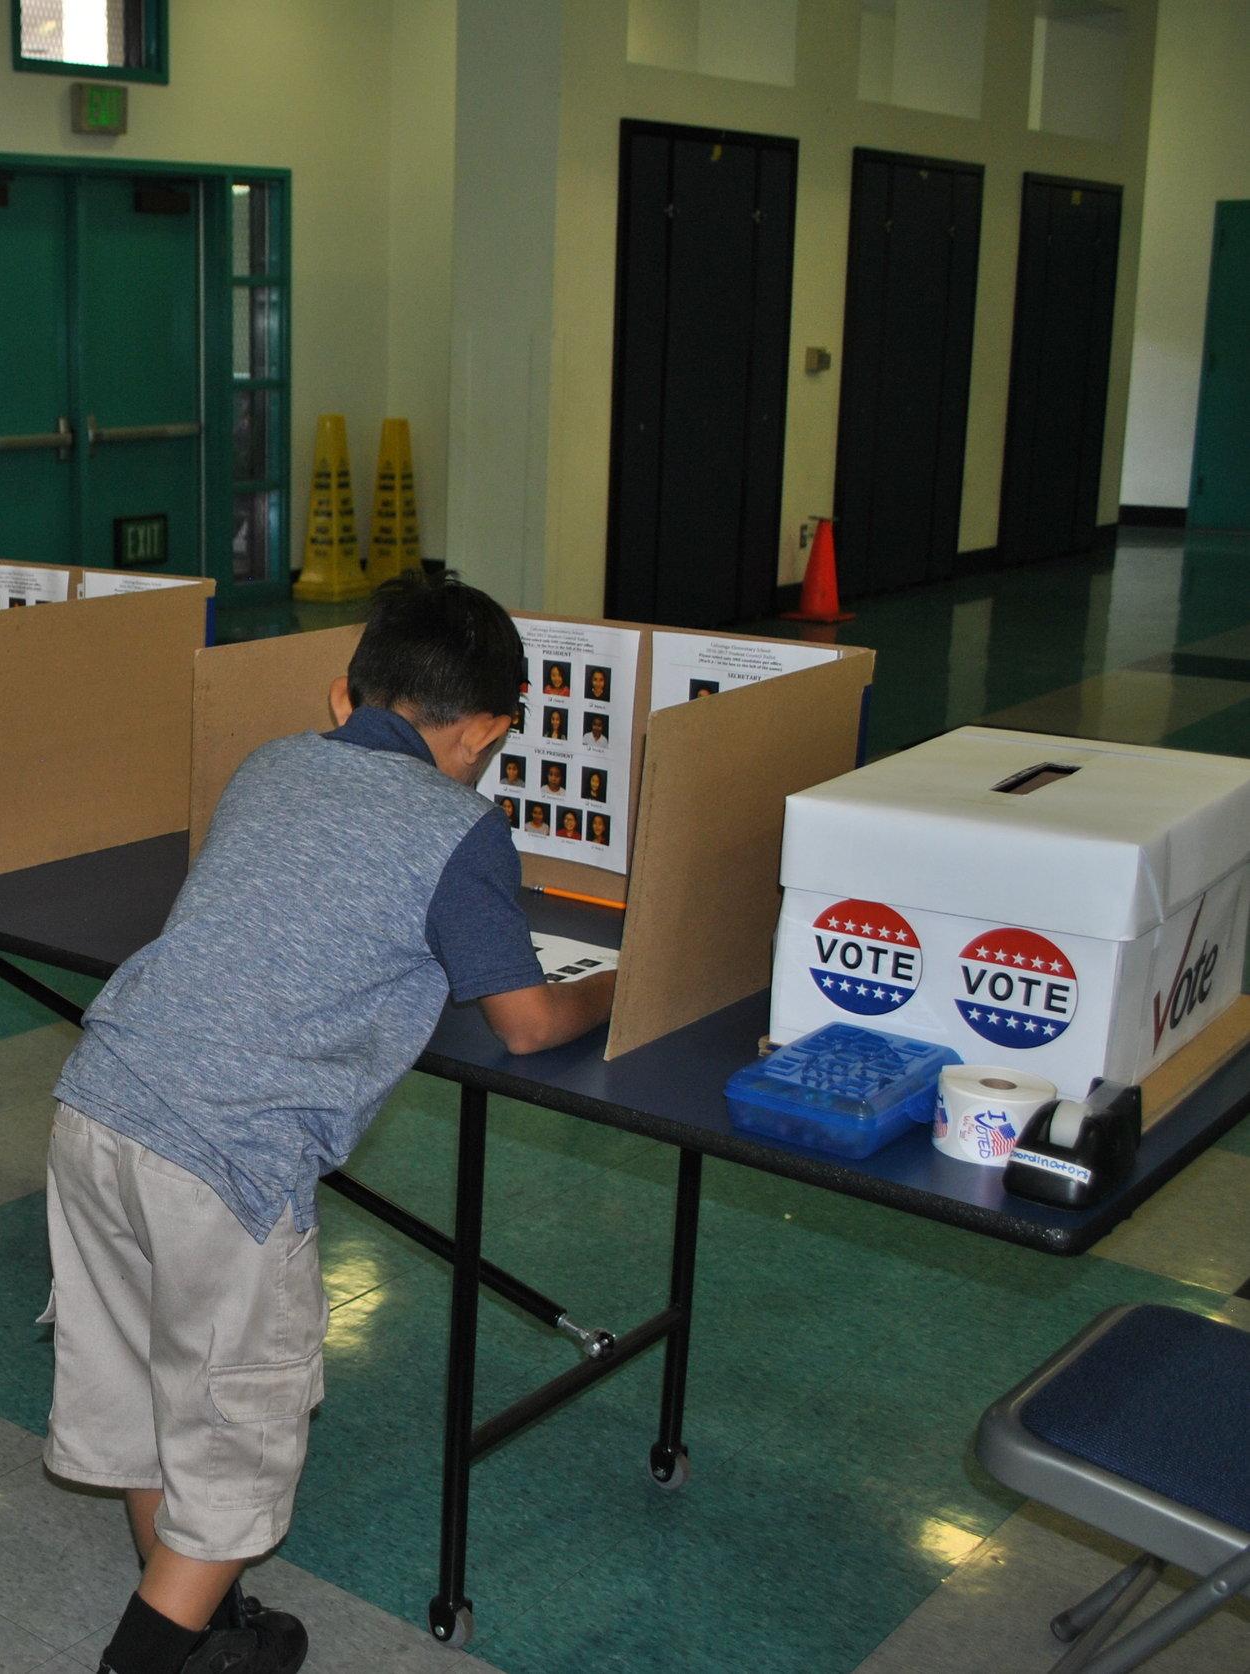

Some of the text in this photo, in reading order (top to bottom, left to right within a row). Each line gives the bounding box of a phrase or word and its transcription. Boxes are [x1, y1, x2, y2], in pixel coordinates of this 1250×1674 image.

[127, 523, 161, 558] EXIT
[814, 934, 916, 982] VOTE
[960, 965, 1070, 1014] VOTE
[974, 1112, 996, 1159] VOTED
[987, 1110, 1007, 1122] I
